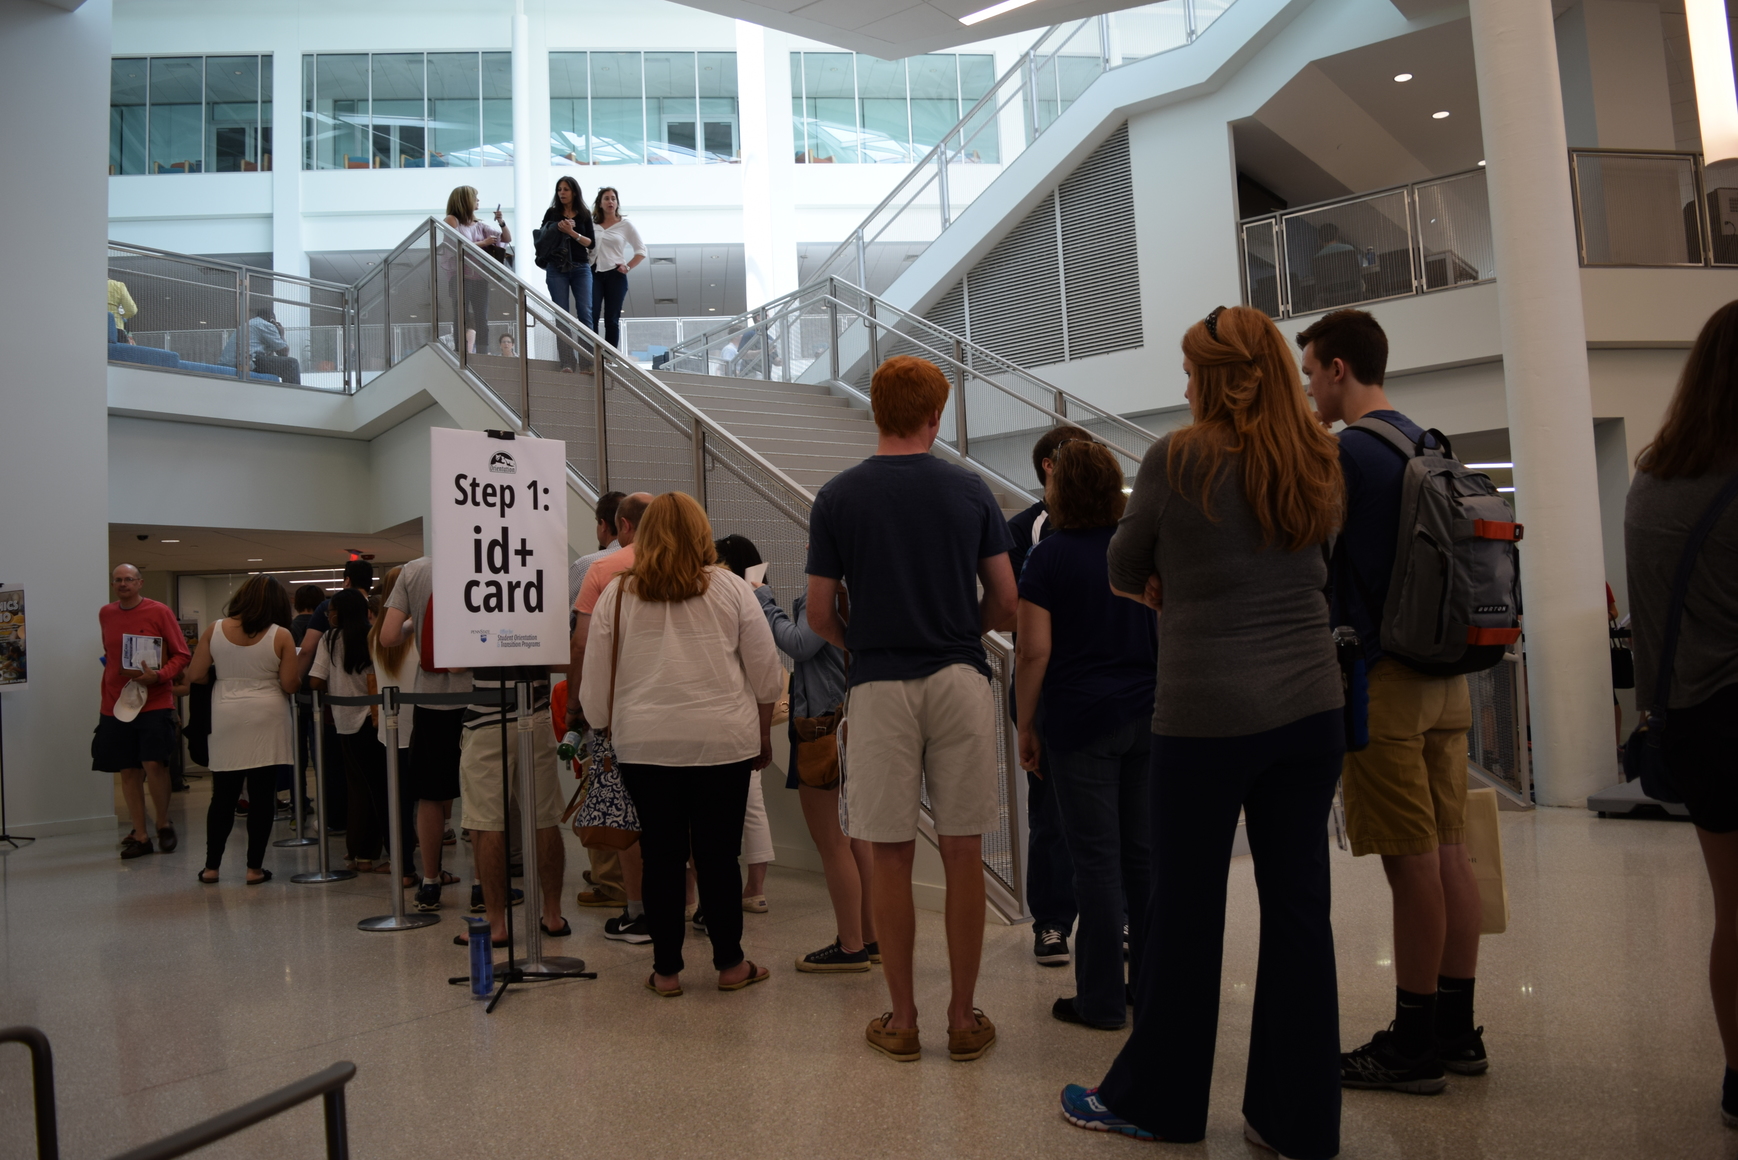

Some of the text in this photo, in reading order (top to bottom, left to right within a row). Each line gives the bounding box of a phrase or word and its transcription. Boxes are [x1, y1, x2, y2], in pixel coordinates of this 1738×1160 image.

[454, 473, 550, 518] Step 1:
[473, 525, 534, 575] id+
[463, 569, 544, 613] card
[522, 641, 541, 649] Programs
